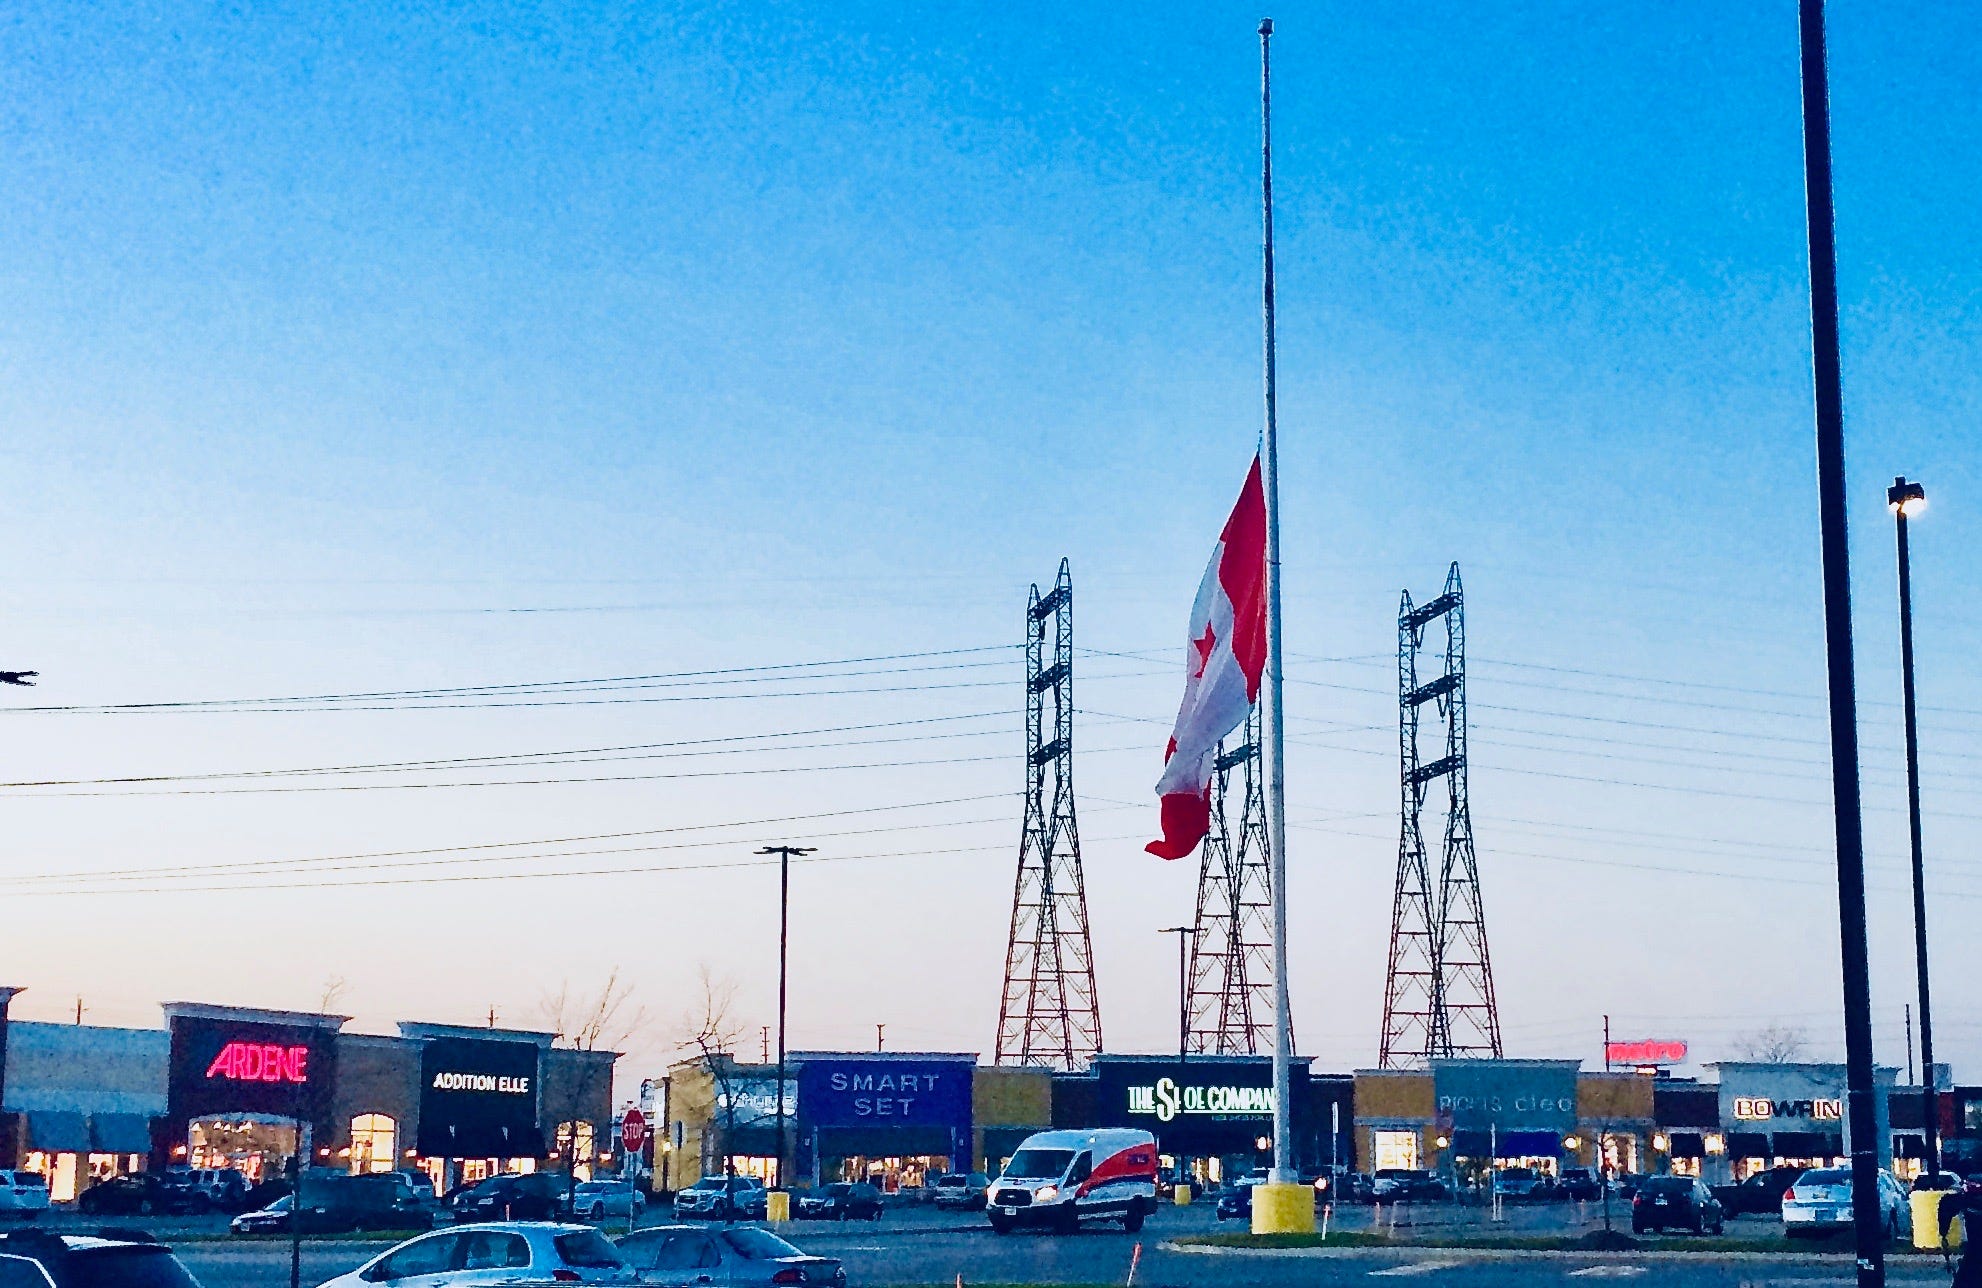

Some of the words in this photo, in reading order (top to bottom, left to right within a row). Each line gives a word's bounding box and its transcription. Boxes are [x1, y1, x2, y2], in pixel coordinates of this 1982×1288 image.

[206, 1043, 308, 1082] ARDENE
[433, 1073, 496, 1091] ADDITION
[499, 1076, 529, 1093] ELLE
[831, 1073, 940, 1091] SMART
[855, 1098, 915, 1115] SET
[1127, 1086, 1156, 1110] THE
[1207, 1086, 1275, 1111] COMPAN
[1515, 1094, 1573, 1112] cleo
[1734, 1098, 1842, 1119] BOWRIN
[623, 1122, 644, 1140] STOP
